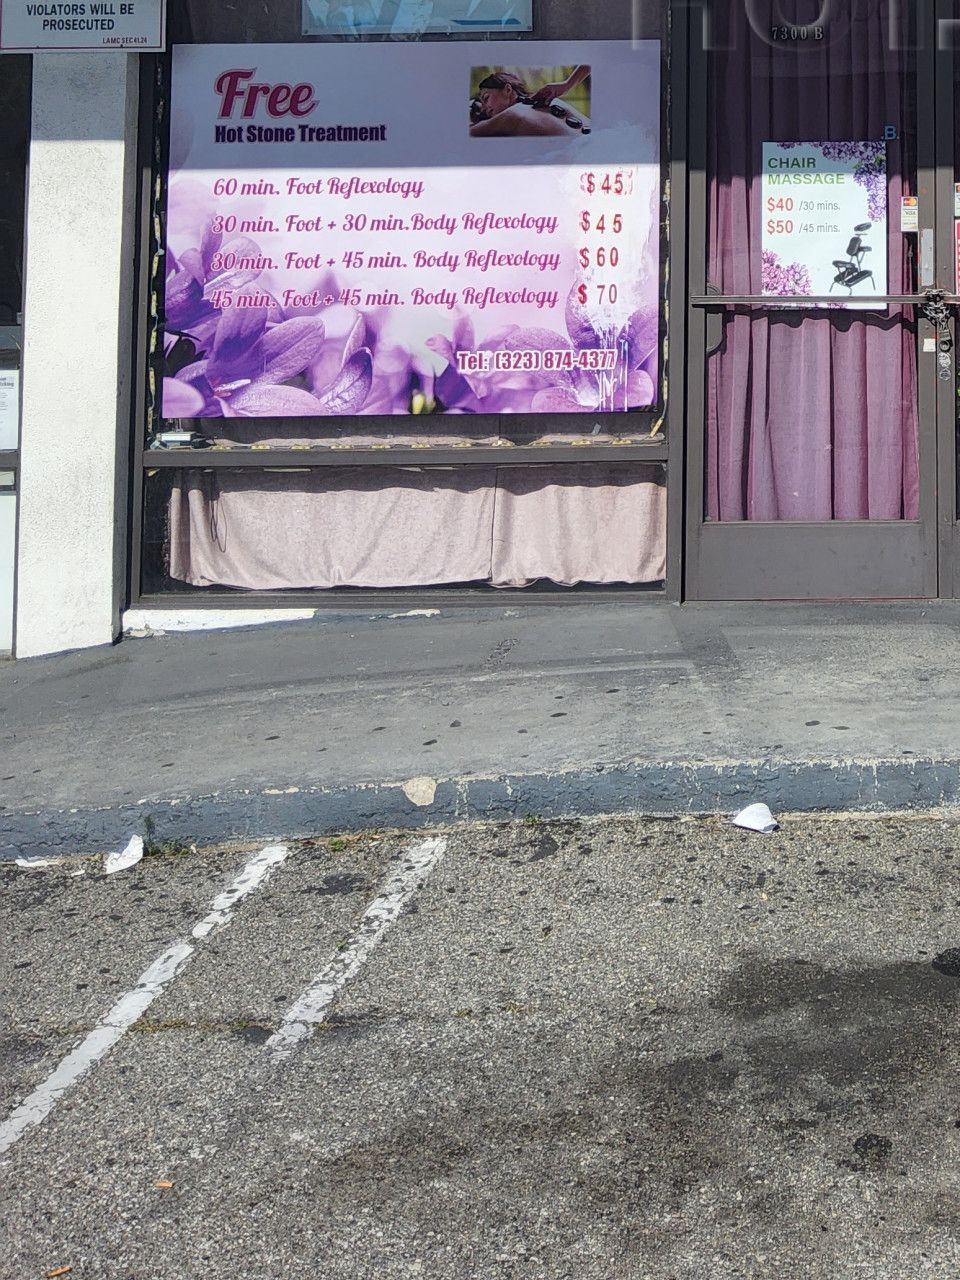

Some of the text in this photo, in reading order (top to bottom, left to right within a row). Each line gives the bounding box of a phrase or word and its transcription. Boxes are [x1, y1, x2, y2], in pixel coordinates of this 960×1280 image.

[26, 4, 134, 16] VIOLATORS WILL BE
[42, 19, 115, 30] PROSECUTED
[771, 27, 823, 40] 7300 B
[215, 67, 320, 119] Free
[215, 124, 386, 144] Hot Stone Treatment
[768, 157, 816, 169] CHAIR
[213, 176, 425, 199] 60 min. Foot Reflexology
[768, 173, 845, 185] MASSAGE
[767, 196, 840, 212] $40 /30 mins.
[212, 212, 560, 236] 30 min. Foot + 30 min. Body Reflexology
[767, 219, 840, 234] $50 /45 mins.
[211, 249, 561, 272] 30 min. Foot + 45 min. Body Reflexology
[210, 286, 560, 310] 45 min. Foot + 45 min. Body Reflexology
[458, 350, 618, 372] Tel: (323) 874-4377
